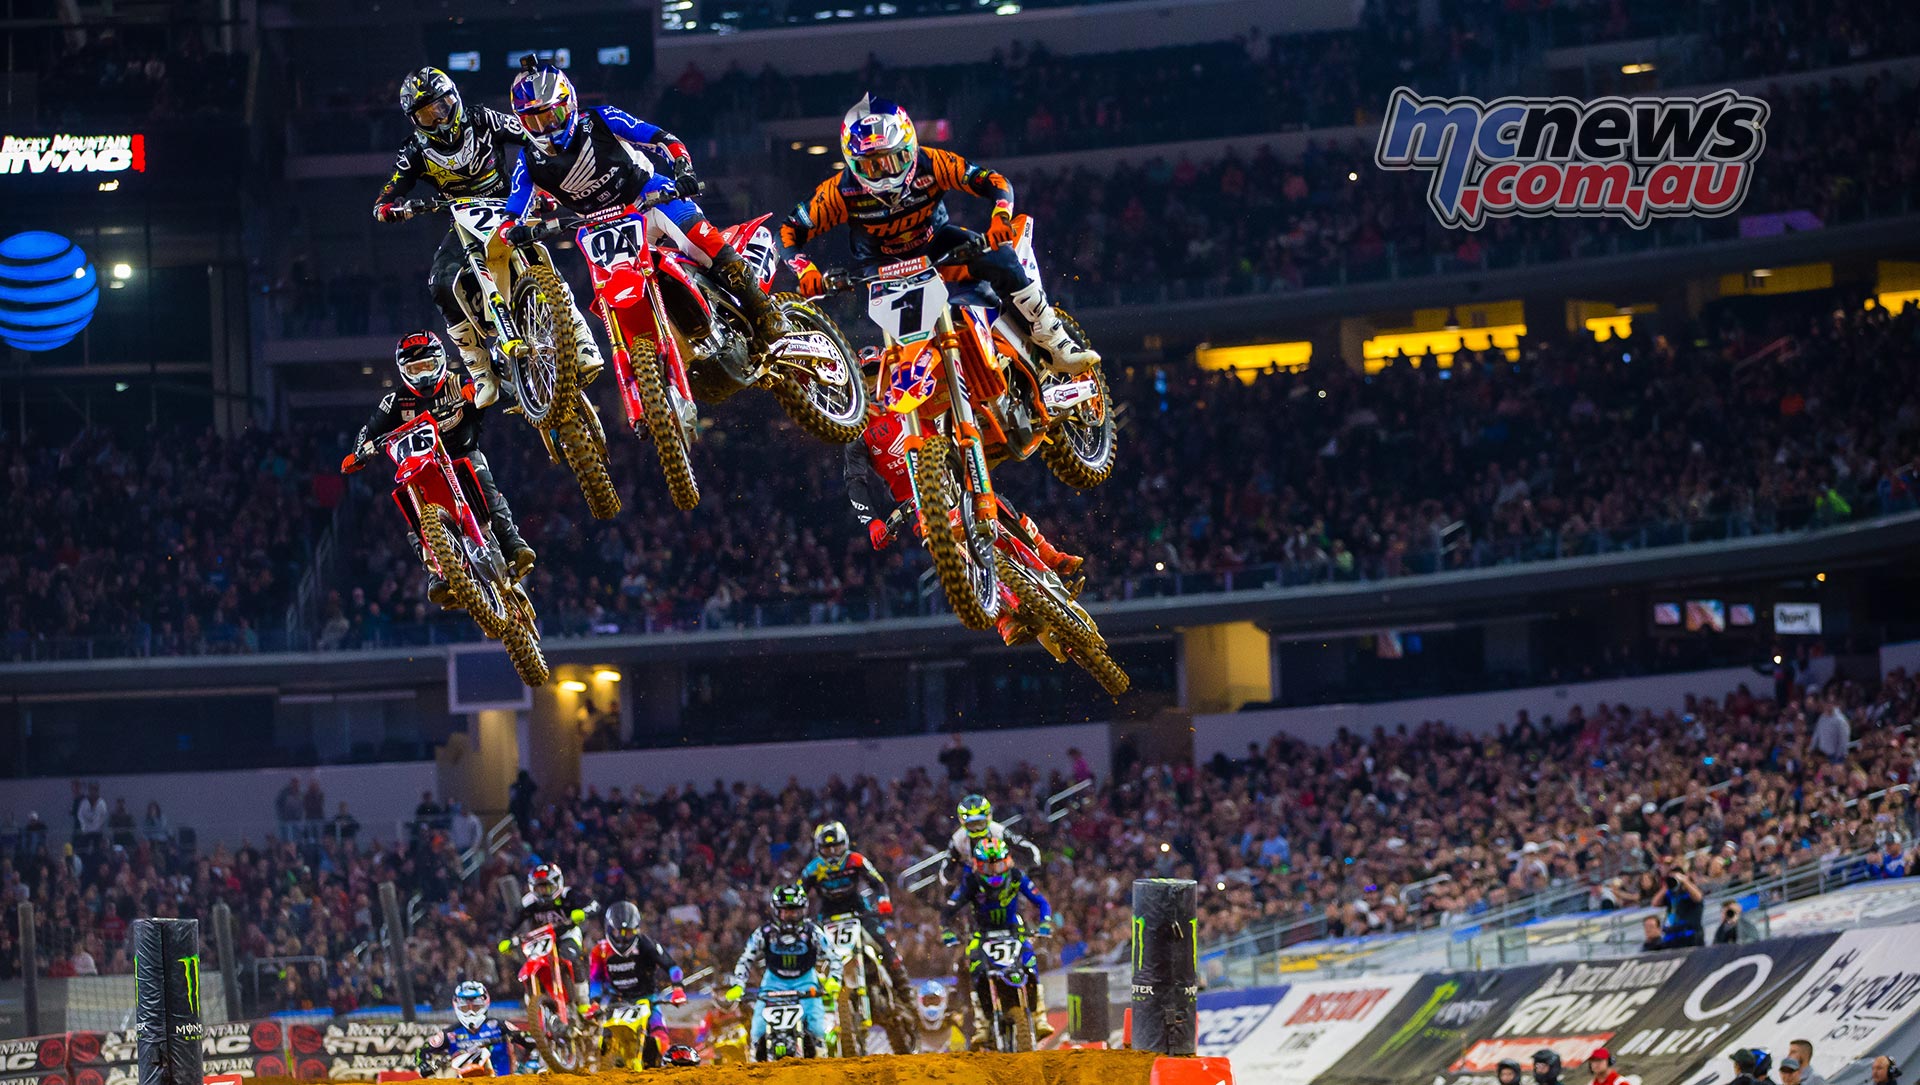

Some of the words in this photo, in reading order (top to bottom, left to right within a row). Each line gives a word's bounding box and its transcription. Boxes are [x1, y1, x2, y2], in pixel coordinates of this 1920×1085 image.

[571, 165, 620, 200] HONDA
[585, 204, 622, 220] RENTHAL
[592, 225, 640, 269] 94
[881, 257, 922, 273] RENTHAL
[891, 287, 925, 336] 1
[868, 421, 891, 441] FLY
[770, 1007, 801, 1027] 37
[1616, 1022, 1731, 1056] OAKLEY
